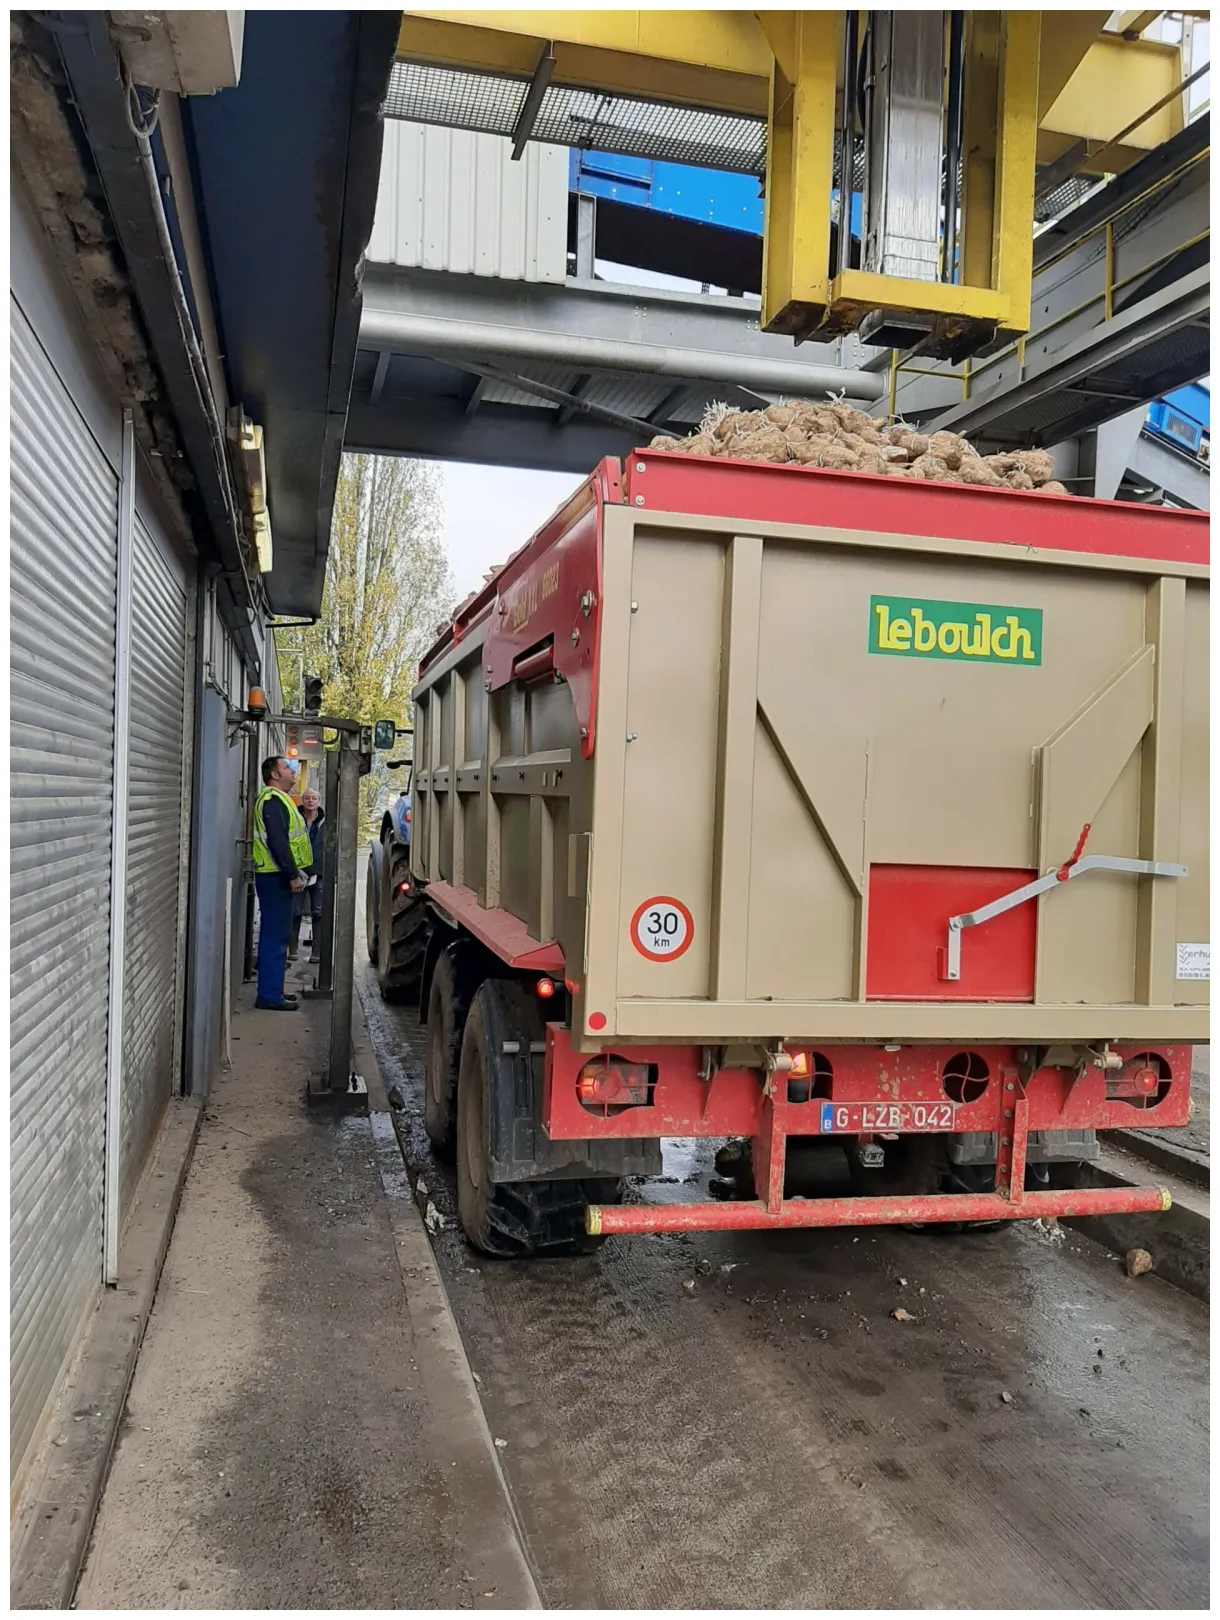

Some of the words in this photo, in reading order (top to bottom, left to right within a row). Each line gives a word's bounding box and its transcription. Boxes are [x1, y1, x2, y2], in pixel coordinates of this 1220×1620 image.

[647, 911, 678, 935] 30
[653, 936, 670, 947] km
[824, 1119, 832, 1130] B
